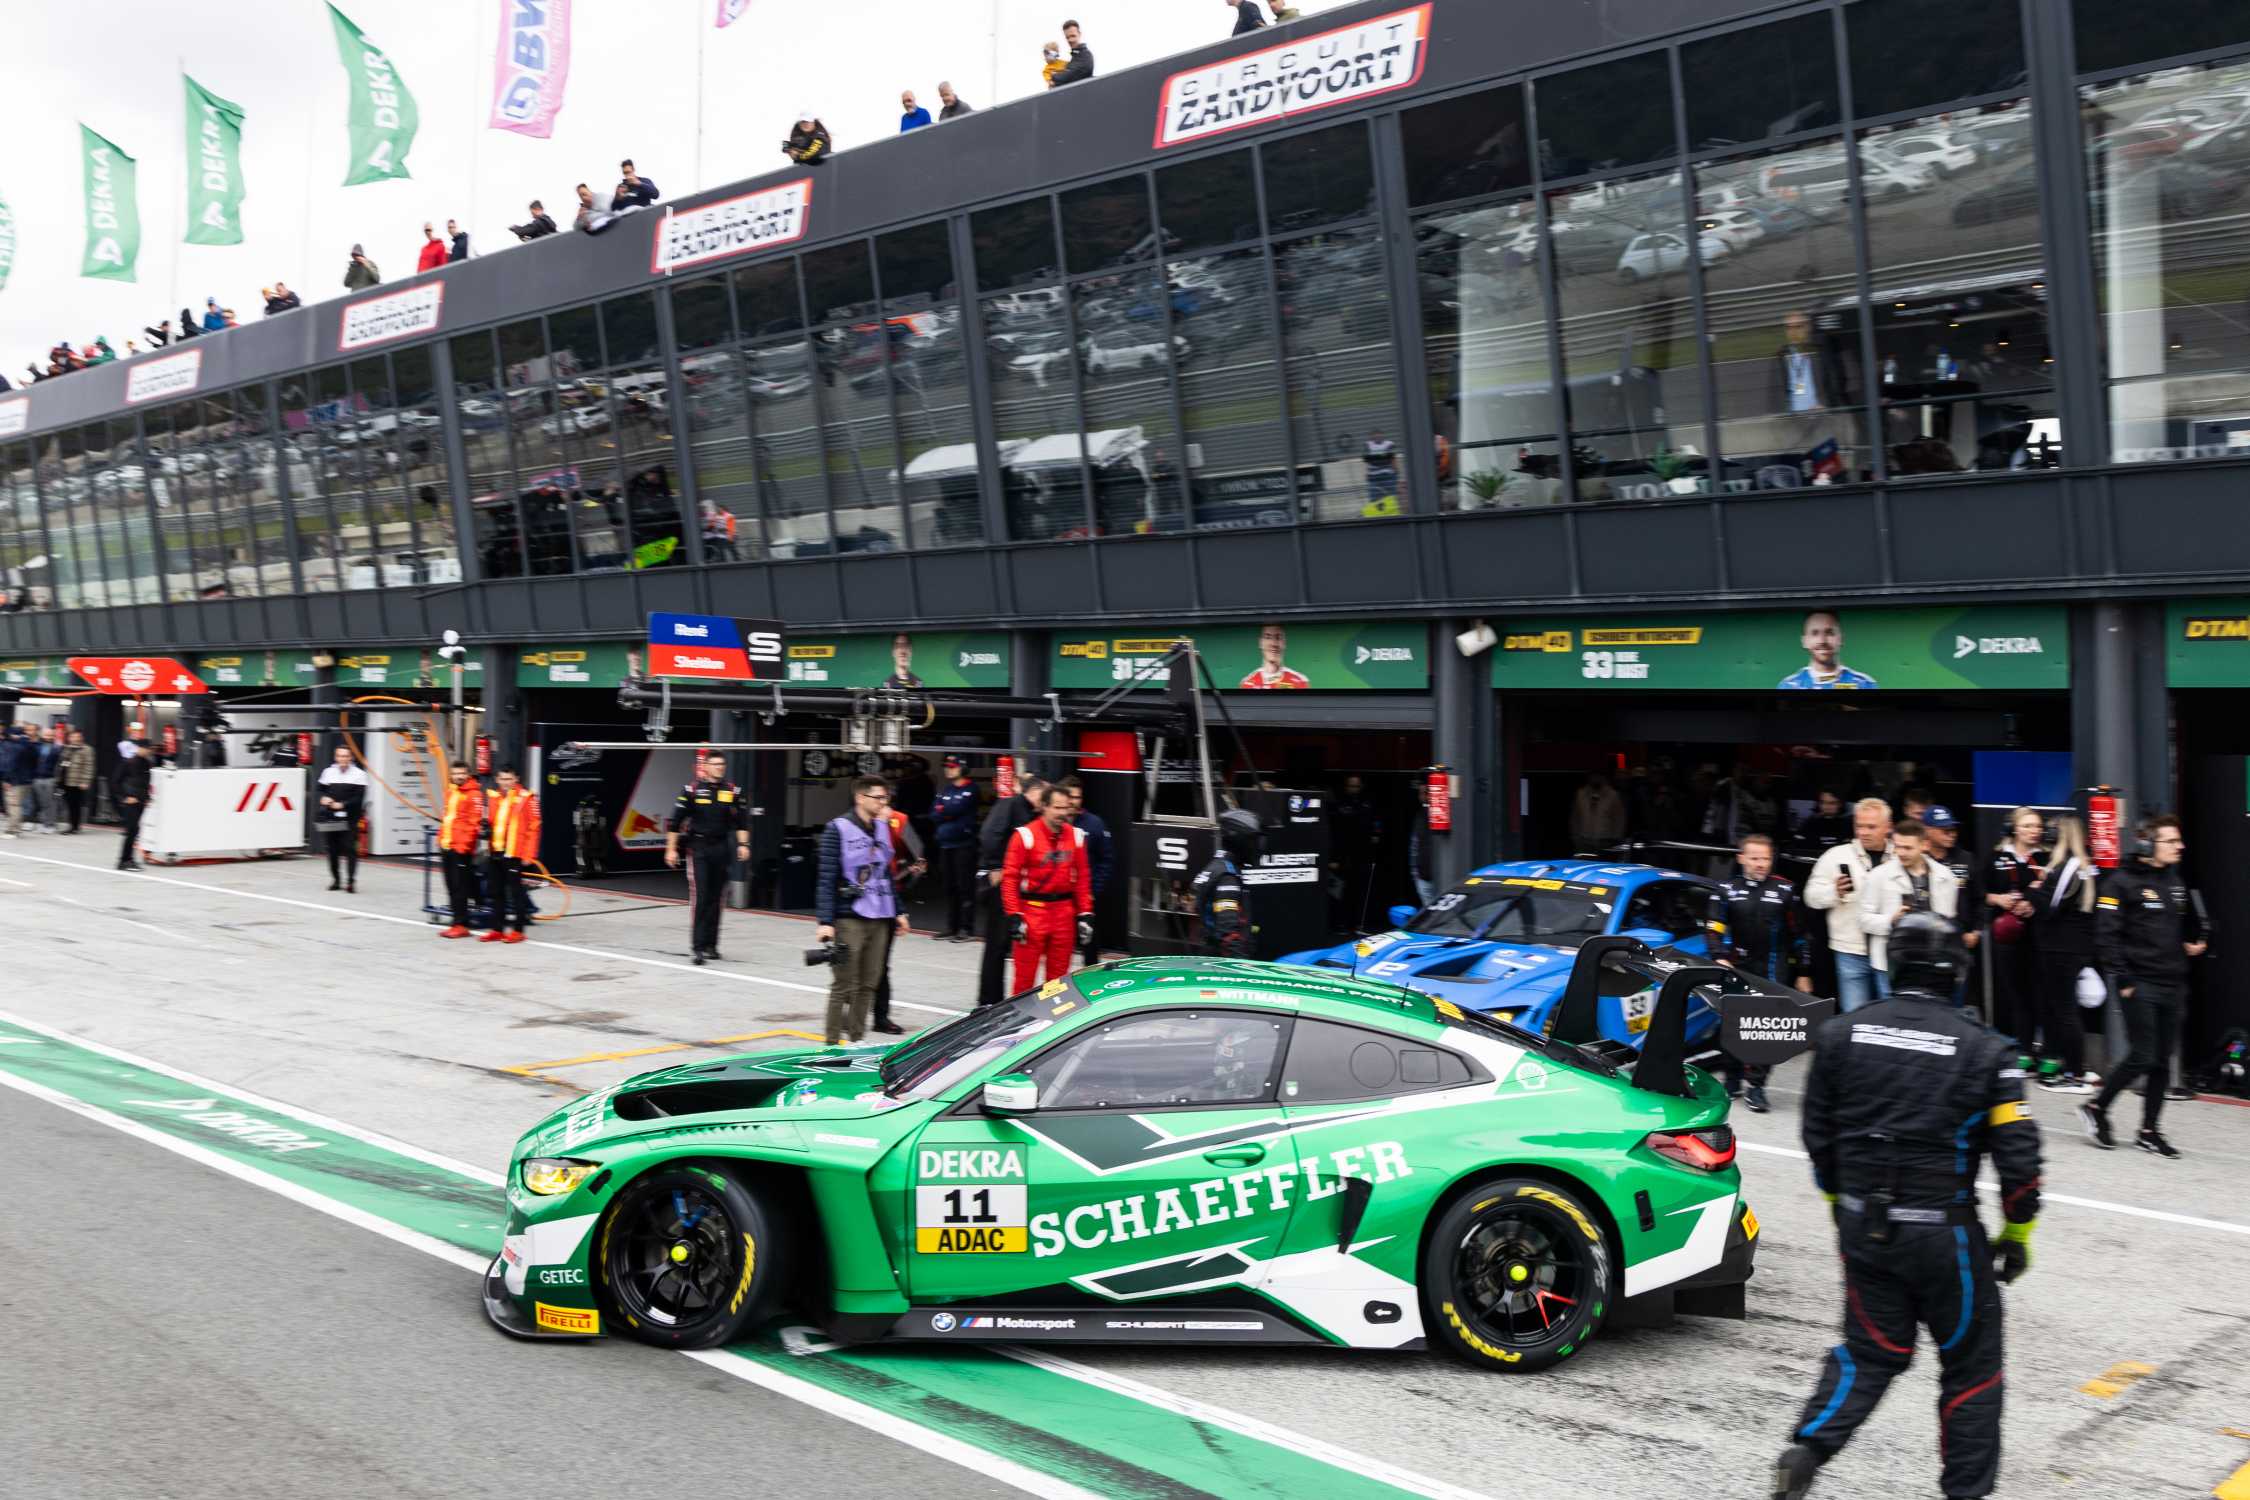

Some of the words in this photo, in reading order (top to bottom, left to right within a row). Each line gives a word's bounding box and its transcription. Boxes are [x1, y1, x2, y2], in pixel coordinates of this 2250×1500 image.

[1179, 23, 1404, 97] CIRCUIT
[361, 36, 400, 129] DEKR
[1177, 45, 1400, 132] ZANDVOORT
[2185, 620, 2249, 638] DTM
[1979, 637, 2043, 653] DEKRA
[1582, 651, 1614, 678] 33
[1196, 975, 1347, 995] PERFORMANCE
[1739, 1030, 1807, 1041] WORKWEAR
[919, 1150, 1025, 1178] DEKRA
[943, 1188, 998, 1223] 11
[1029, 1140, 1414, 1258] SCHAEFFLER
[937, 1228, 1005, 1252] ADAC
[540, 1269, 585, 1284] GETEC
[539, 1307, 593, 1329] PIRELLI
[996, 1317, 1076, 1331] Motorsport
